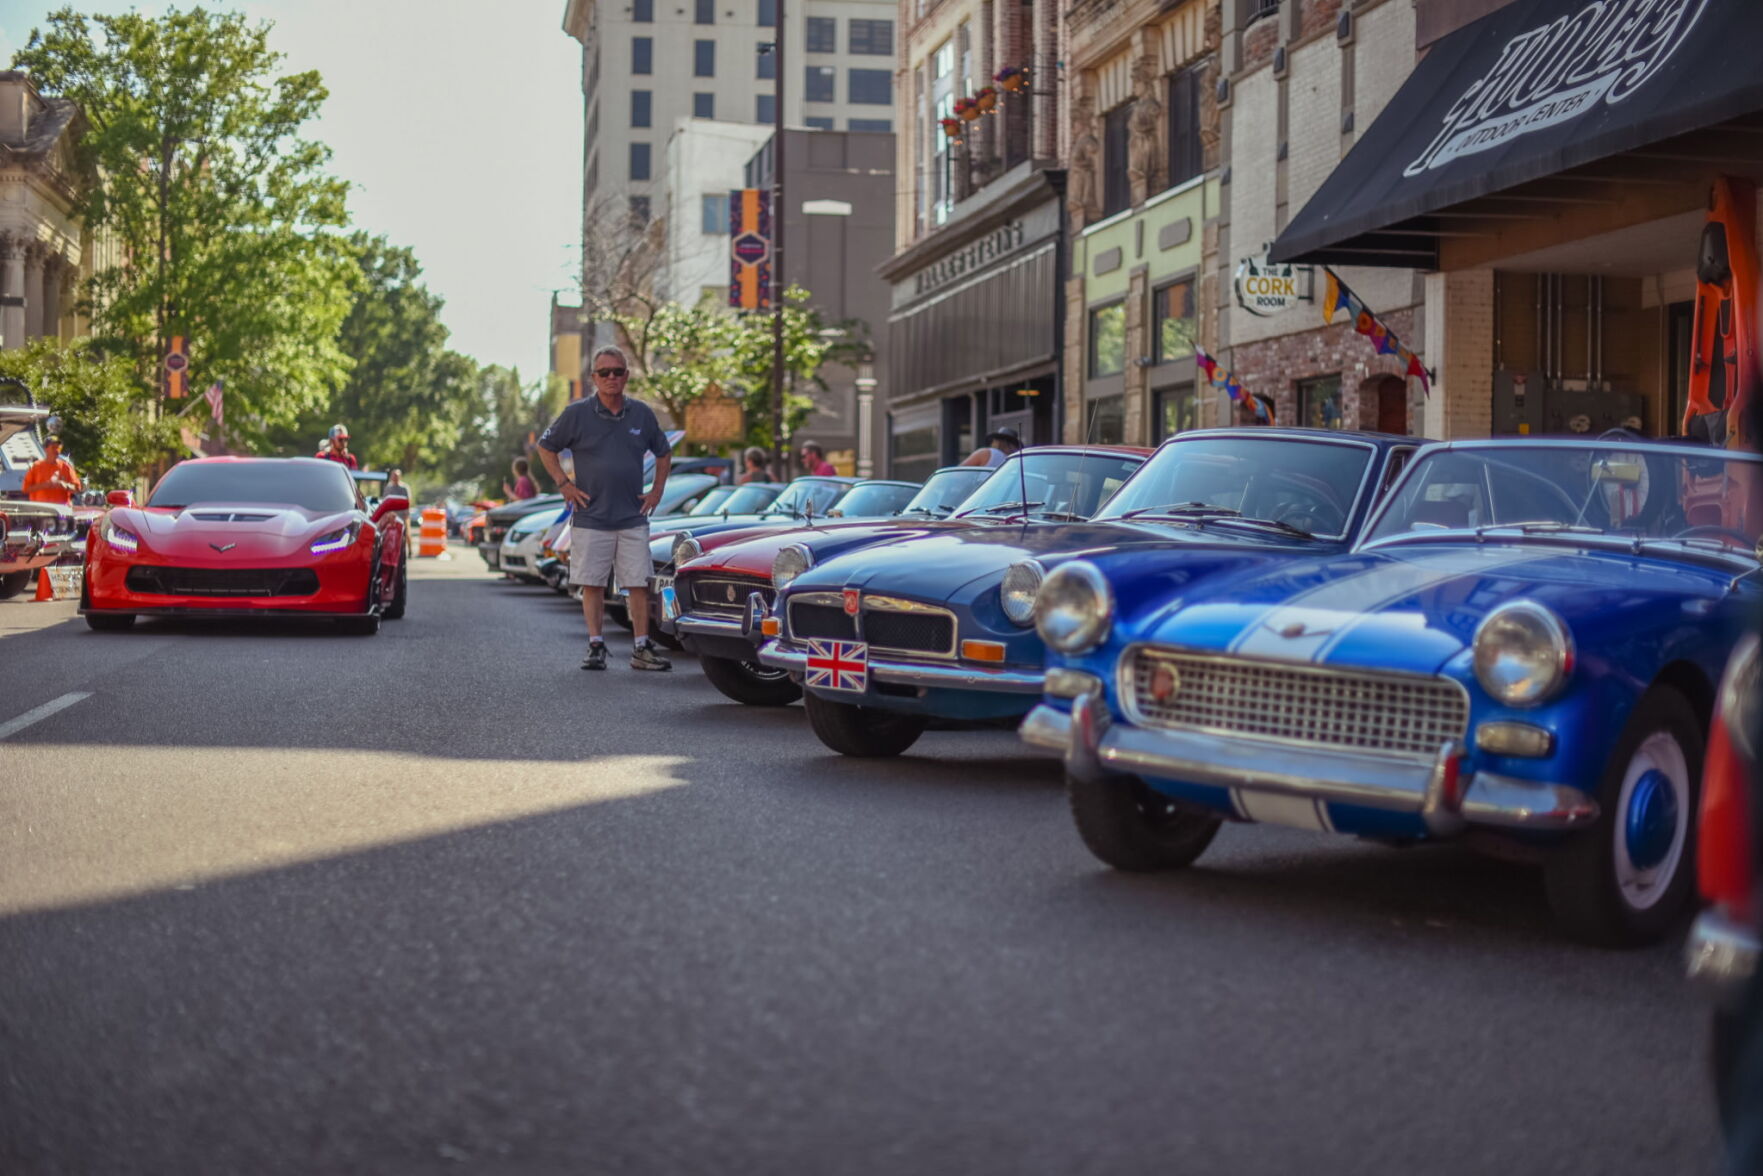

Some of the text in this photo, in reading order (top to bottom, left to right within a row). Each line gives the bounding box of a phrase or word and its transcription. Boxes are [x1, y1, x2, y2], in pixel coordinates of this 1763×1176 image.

[1456, 91, 1590, 152] OUTDOOR CENTER
[1262, 267, 1279, 276] THE
[1246, 277, 1295, 295] CORK
[1257, 296, 1285, 306] ROOM
